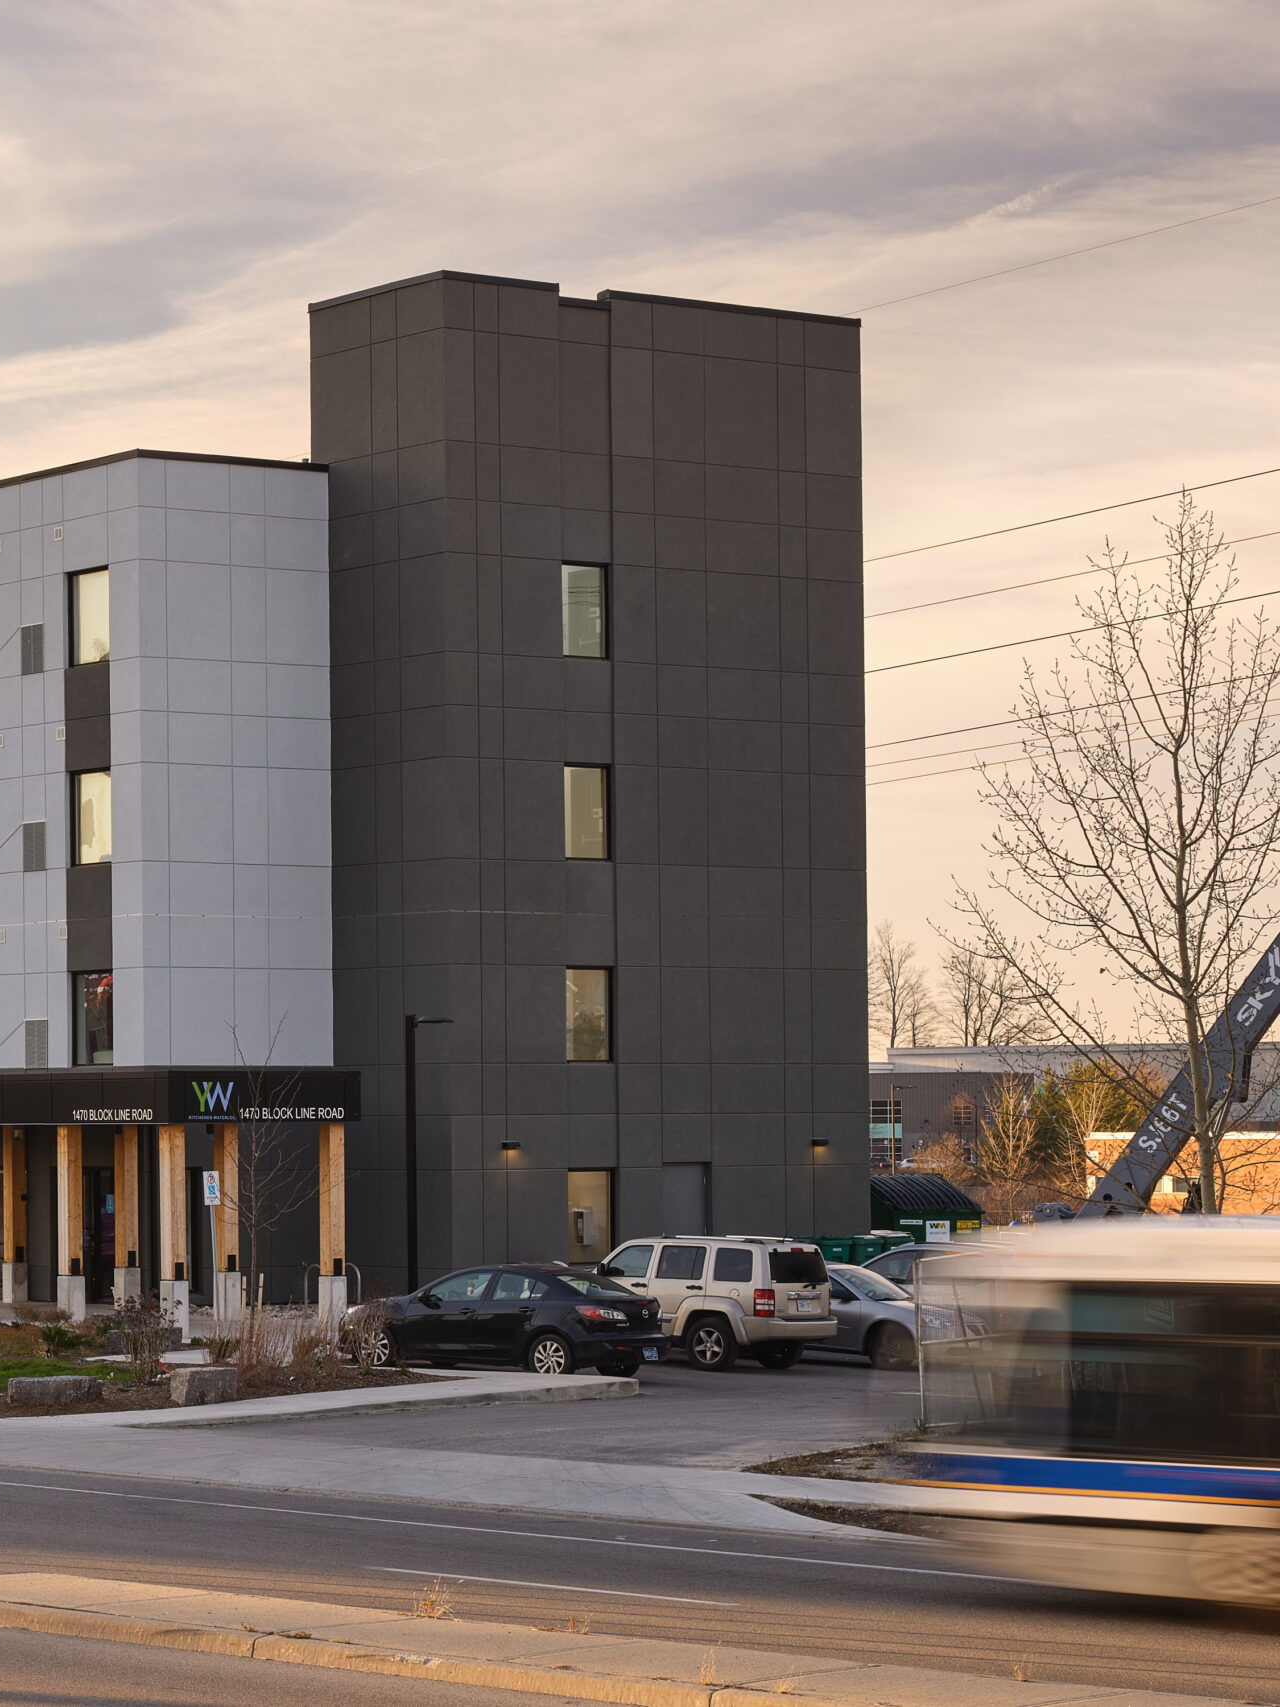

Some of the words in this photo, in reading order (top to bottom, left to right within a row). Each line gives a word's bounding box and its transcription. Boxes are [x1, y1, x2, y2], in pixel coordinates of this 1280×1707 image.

[192, 1081, 234, 1112] YW
[73, 1109, 88, 1121] 1470
[89, 1109, 113, 1121] BLOCK
[115, 1109, 131, 1121] LINE
[132, 1109, 153, 1121] ROAD
[239, 1107, 260, 1119] 1470
[262, 1107, 294, 1119] BLOCK
[295, 1107, 316, 1119] LINE
[318, 1107, 344, 1119] ROAD
